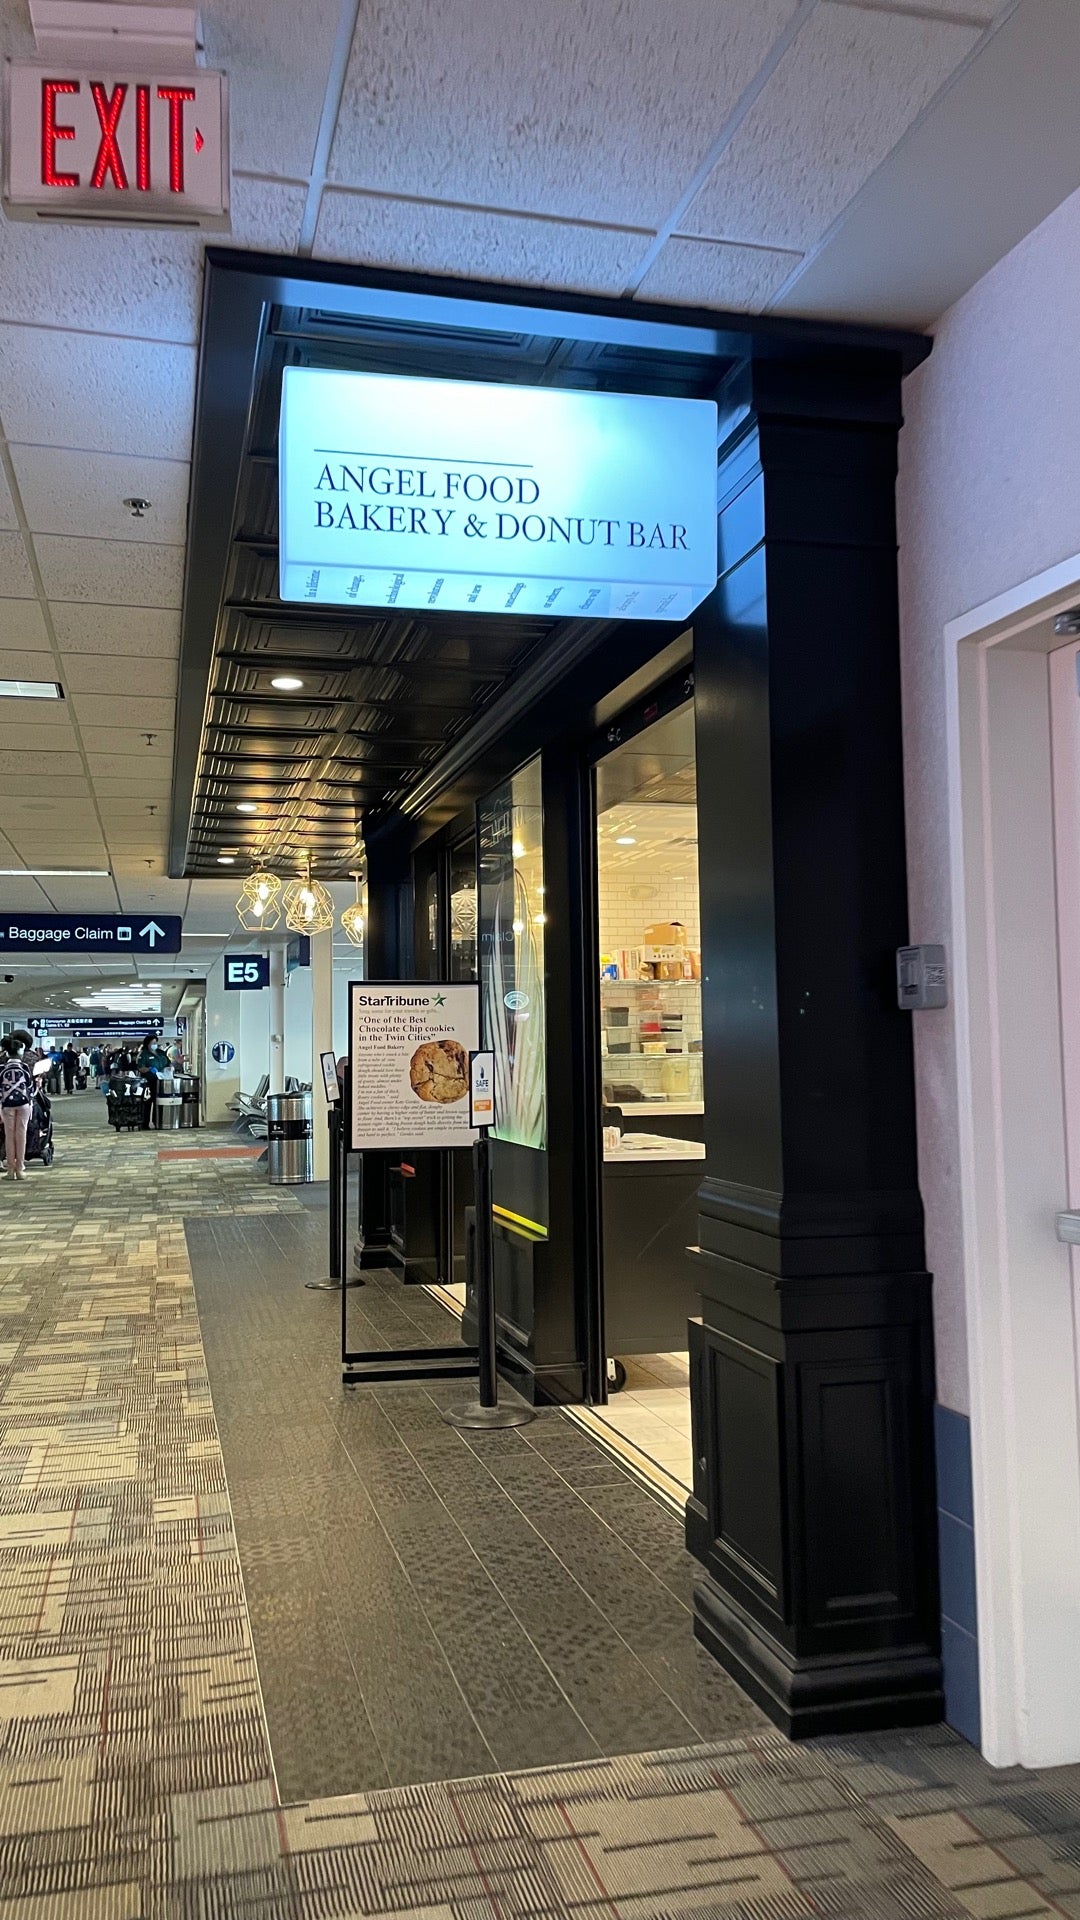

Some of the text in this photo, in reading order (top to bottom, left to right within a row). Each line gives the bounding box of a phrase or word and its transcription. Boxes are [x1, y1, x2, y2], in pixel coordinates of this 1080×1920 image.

[41, 78, 196, 193] EXIT
[313, 463, 540, 505] ANGEL FOOD
[313, 501, 691, 551] BAKERY & DONUT BAR
[8, 926, 114, 942] Baggage Claim
[228, 962, 259, 983] E5
[359, 995, 430, 1006] StarTribune
[383, 1016, 392, 1024] of
[394, 1016, 407, 1024] the
[409, 1016, 427, 1024] Best
[358, 1024, 455, 1034] Chocolate Chip cookies
[358, 1033, 367, 1041] in
[385, 1033, 405, 1041] Twin
